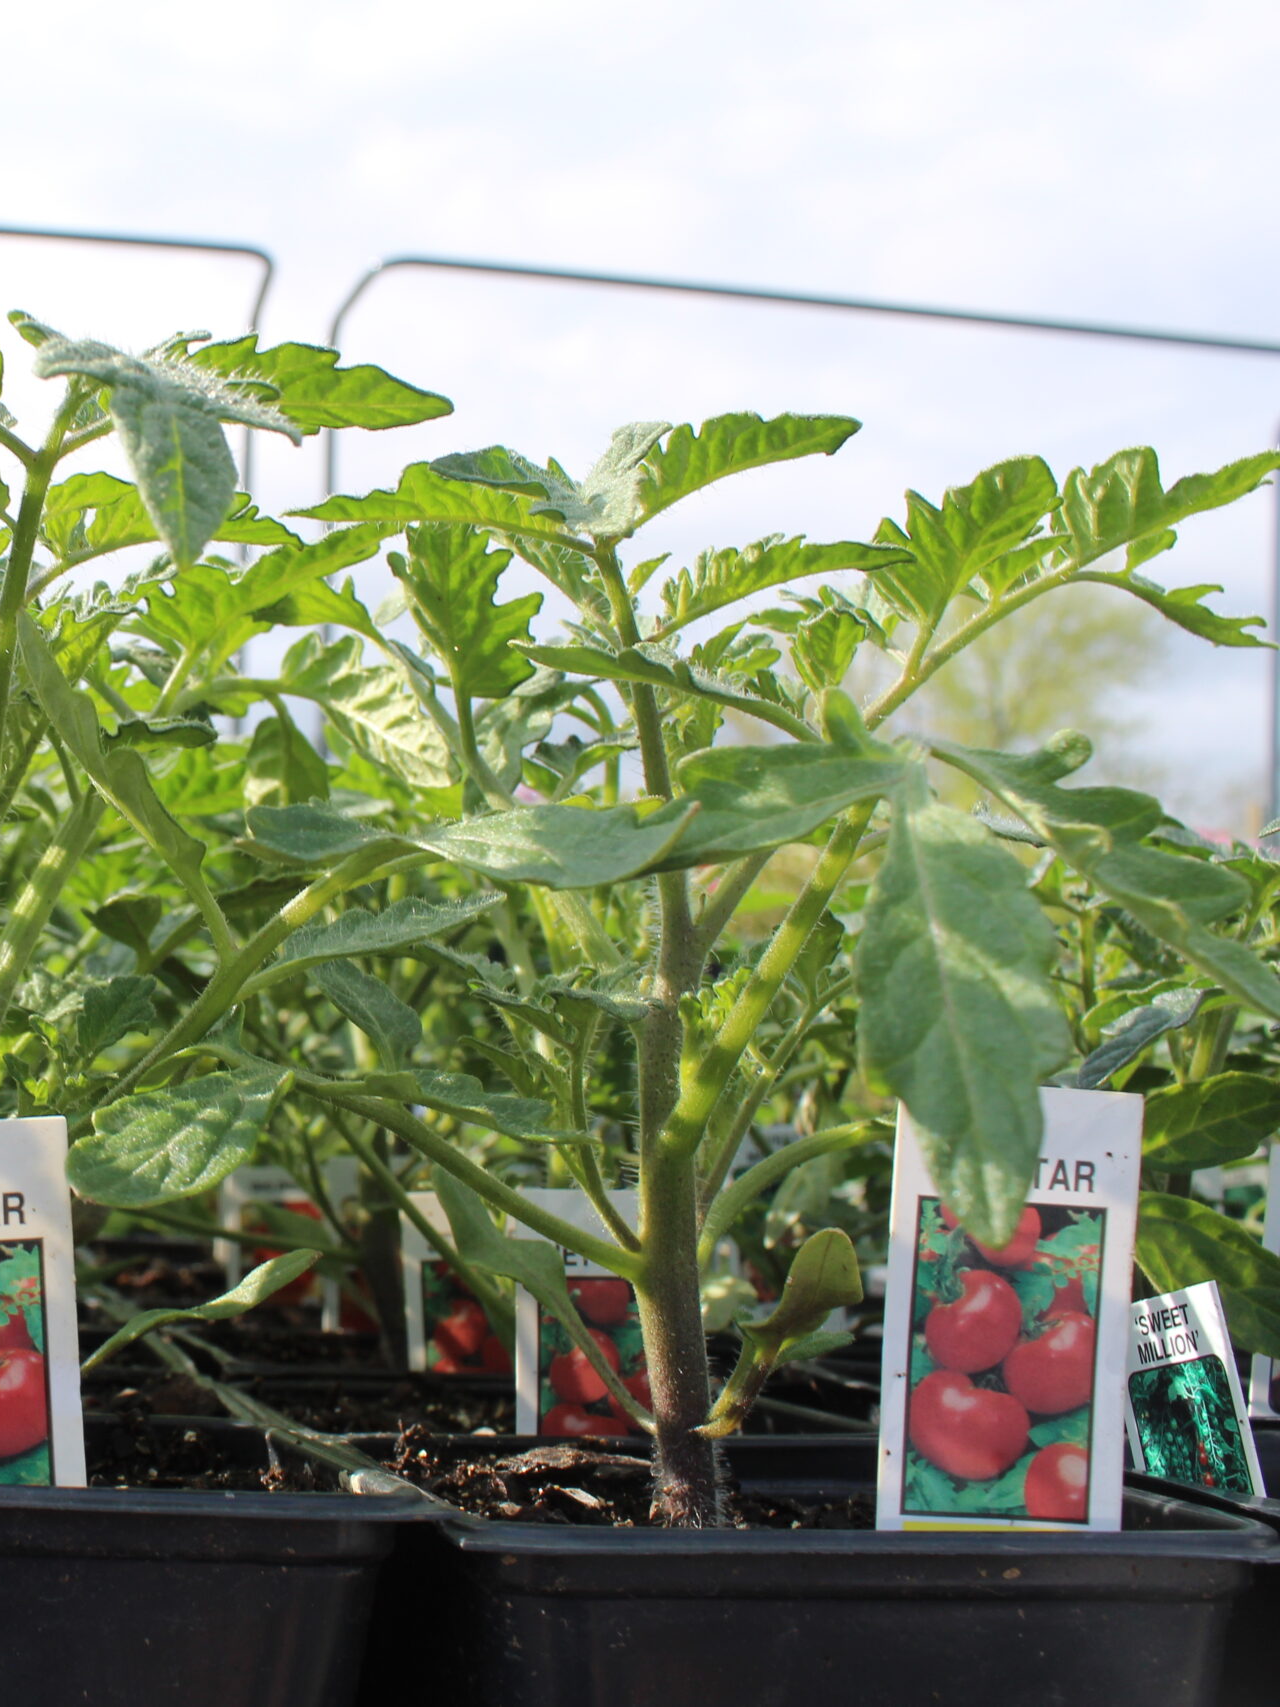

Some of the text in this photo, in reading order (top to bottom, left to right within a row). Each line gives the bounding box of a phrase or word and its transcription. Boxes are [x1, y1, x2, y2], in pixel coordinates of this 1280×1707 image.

[1033, 1158, 1095, 1193] TAR
[1134, 1304, 1189, 1336] 'SWEET
[1137, 1330, 1199, 1365] MILLION'
